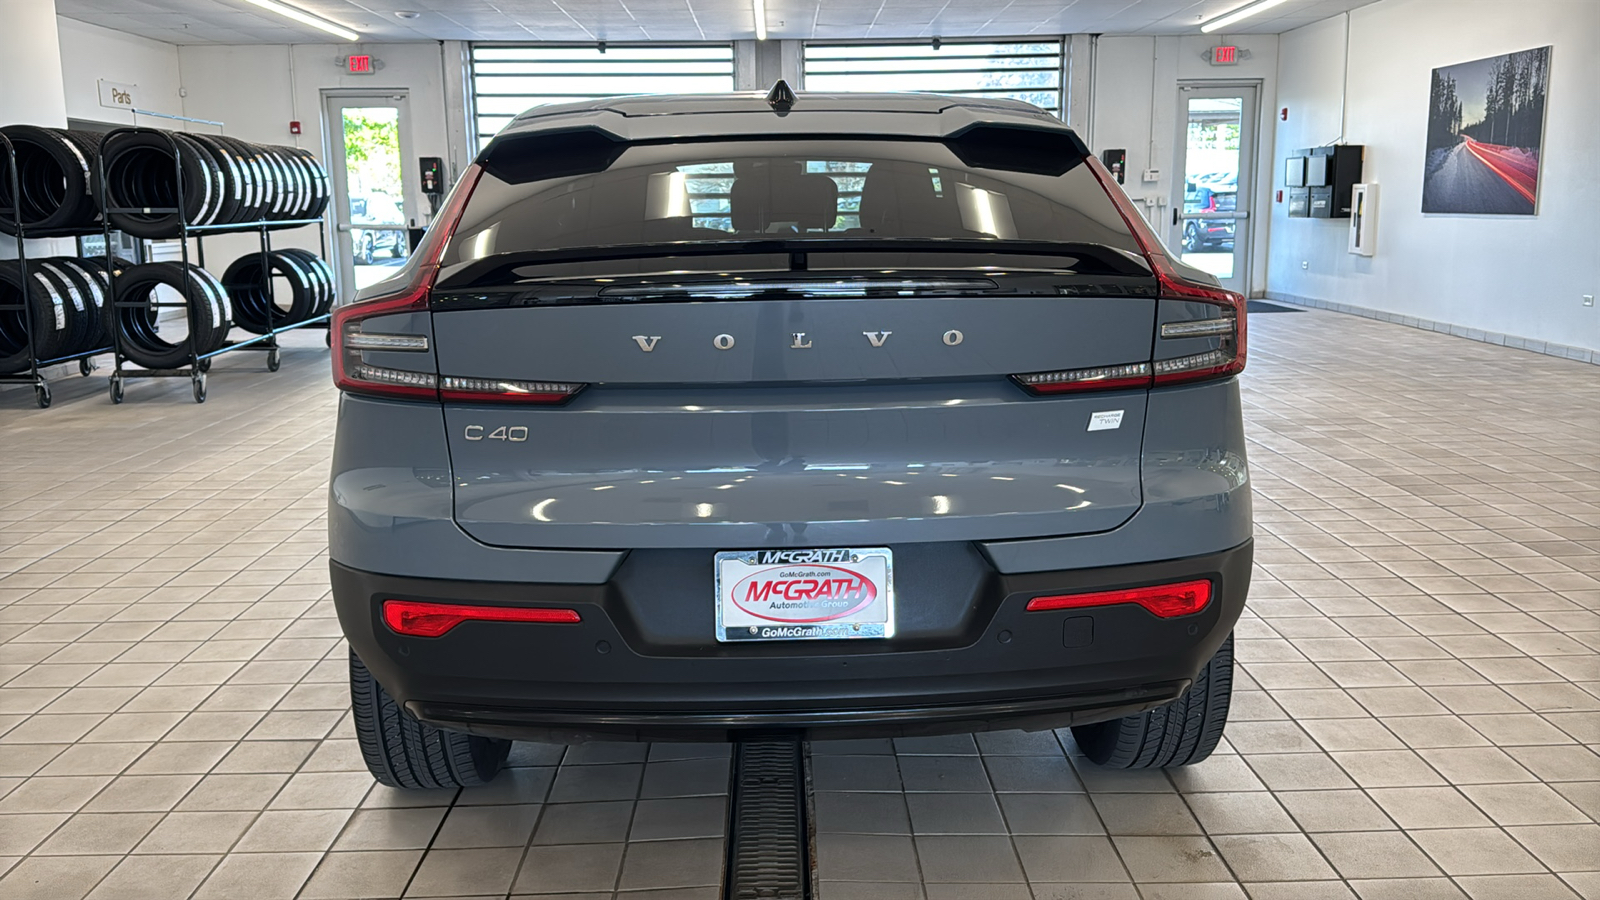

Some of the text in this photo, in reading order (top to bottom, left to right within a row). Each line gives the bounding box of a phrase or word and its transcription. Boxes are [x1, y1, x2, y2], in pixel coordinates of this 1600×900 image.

[1216, 46, 1235, 62] EXIT
[349, 55, 369, 72] EXIT
[112, 87, 131, 105] Parts
[632, 330, 964, 352] VOLVO
[821, 600, 849, 609] Group
